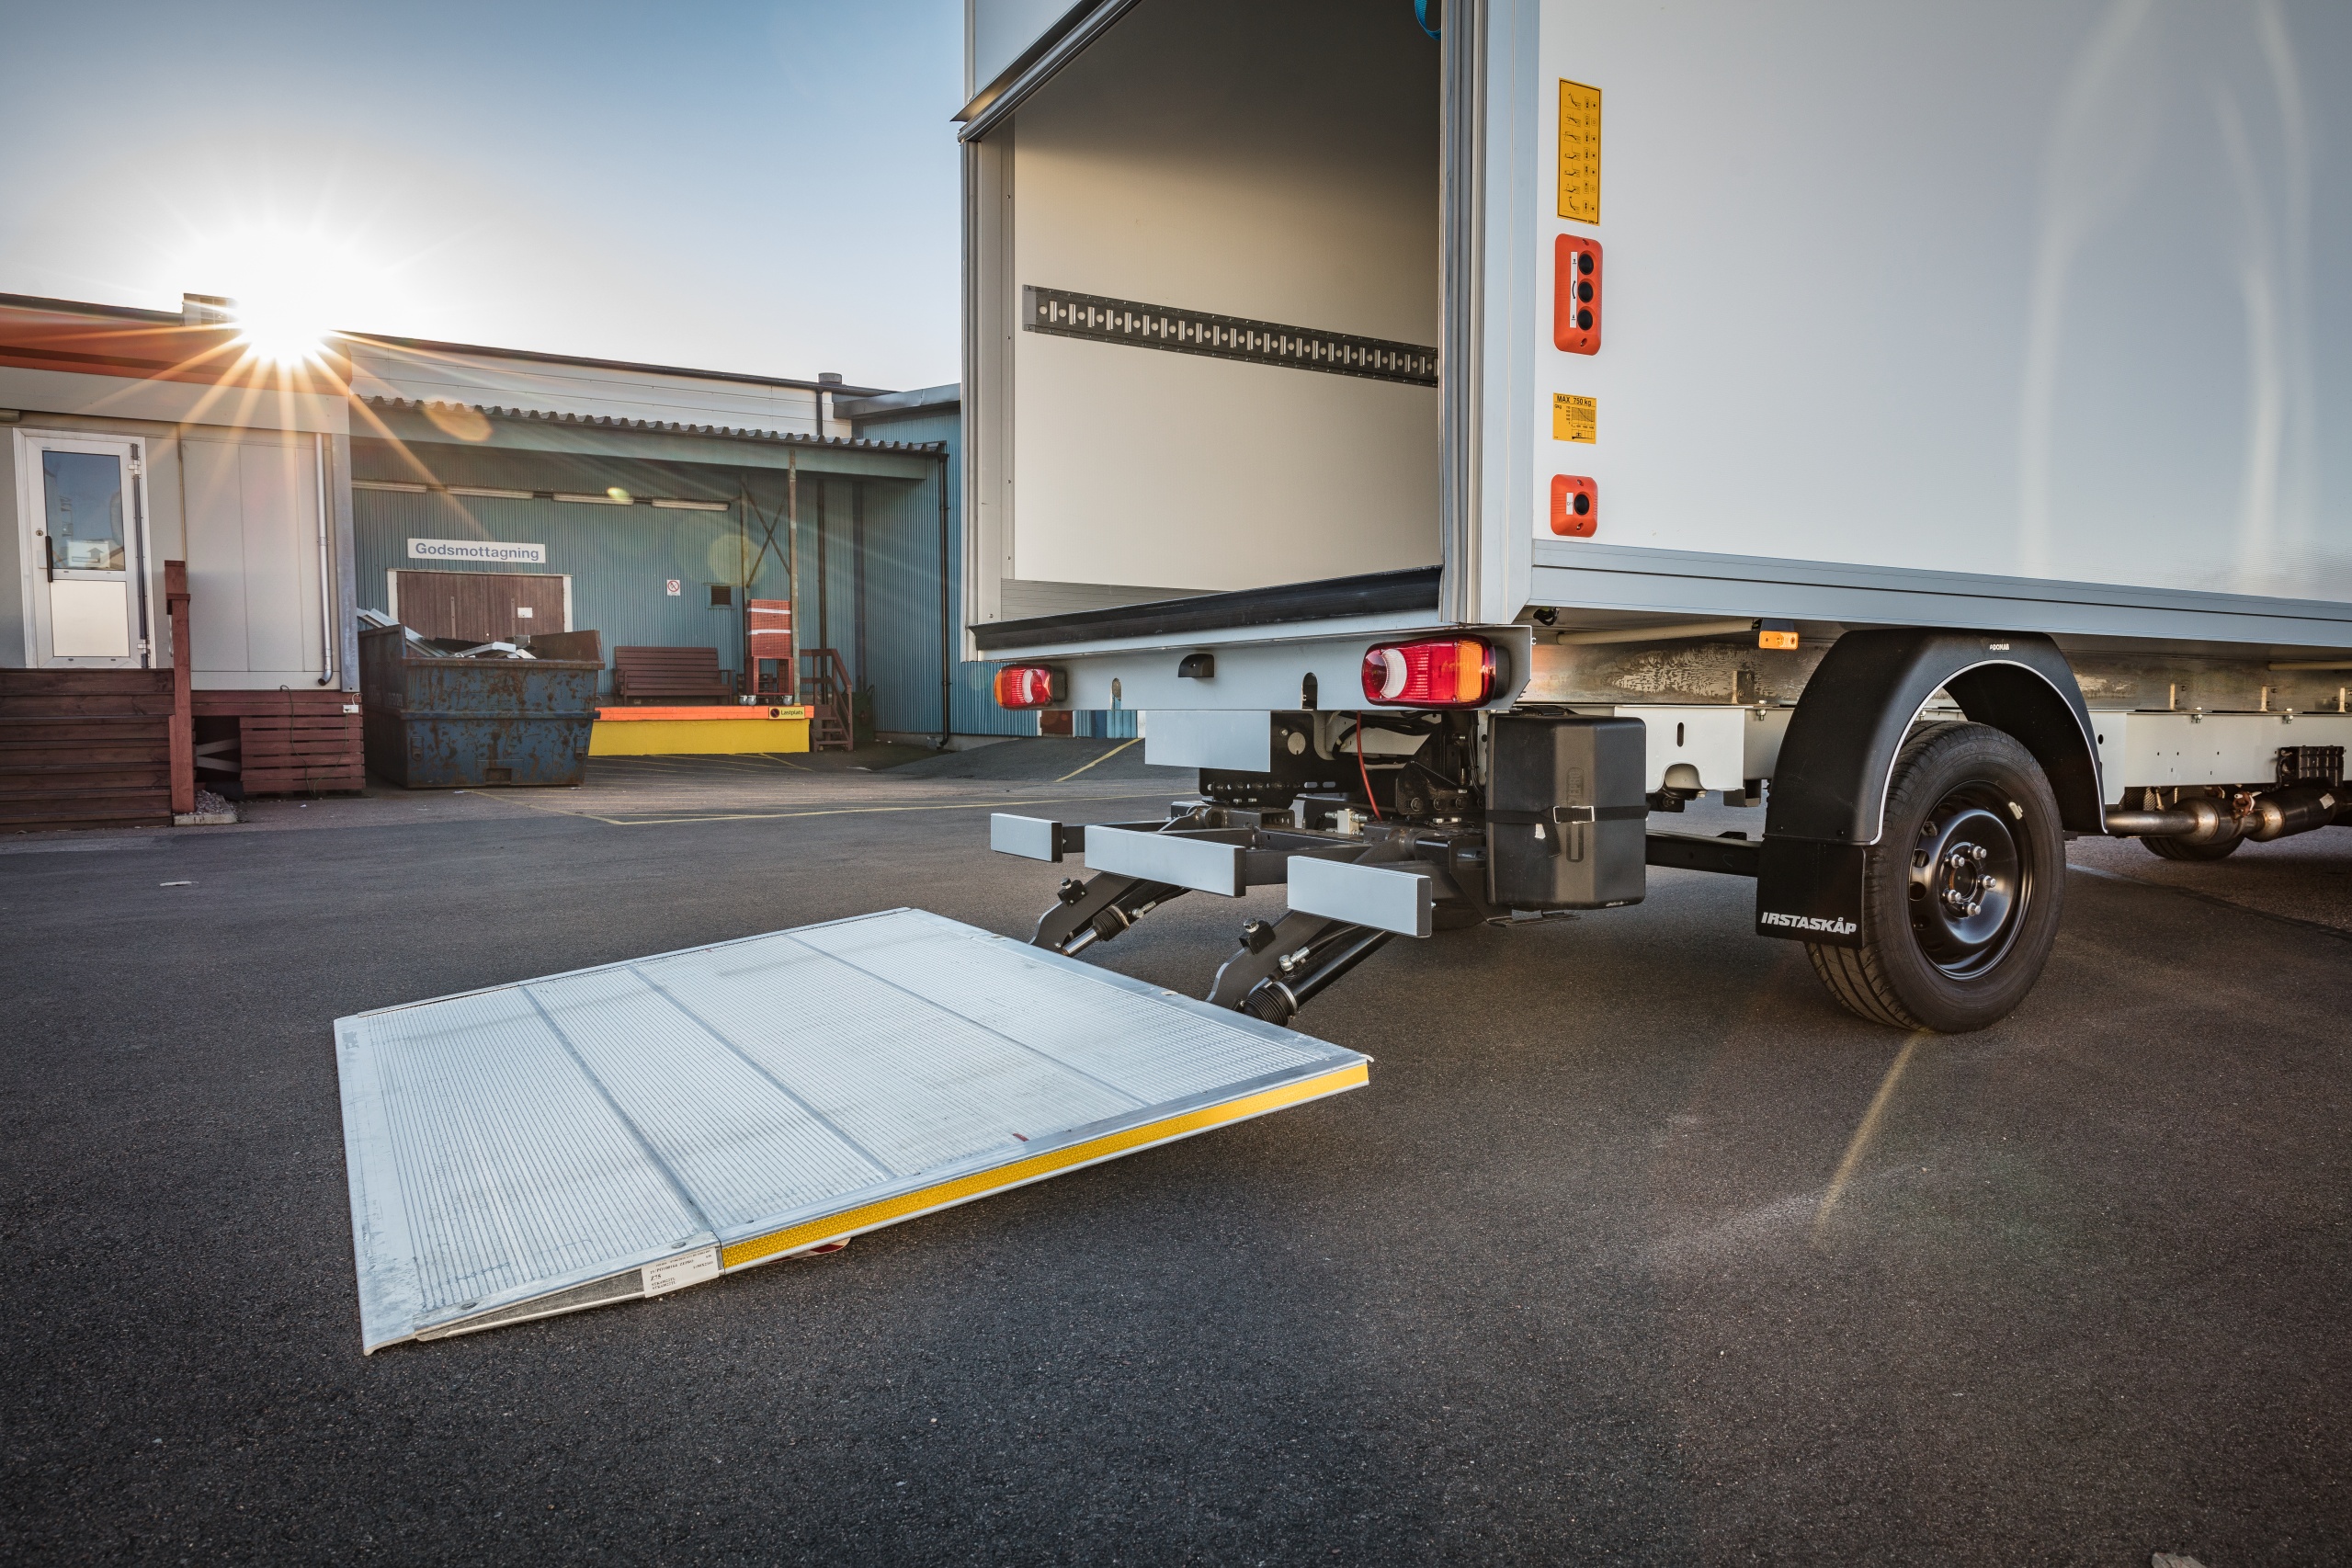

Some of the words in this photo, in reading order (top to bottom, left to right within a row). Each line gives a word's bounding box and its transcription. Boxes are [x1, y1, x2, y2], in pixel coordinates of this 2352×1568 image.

[1557, 395, 1570, 403] MAX
[1574, 397, 1584, 405] 750
[1585, 399, 1591, 407] kg
[415, 542, 539, 562] Godsmottagning
[1761, 912, 1857, 935] IRSTASKÅP
